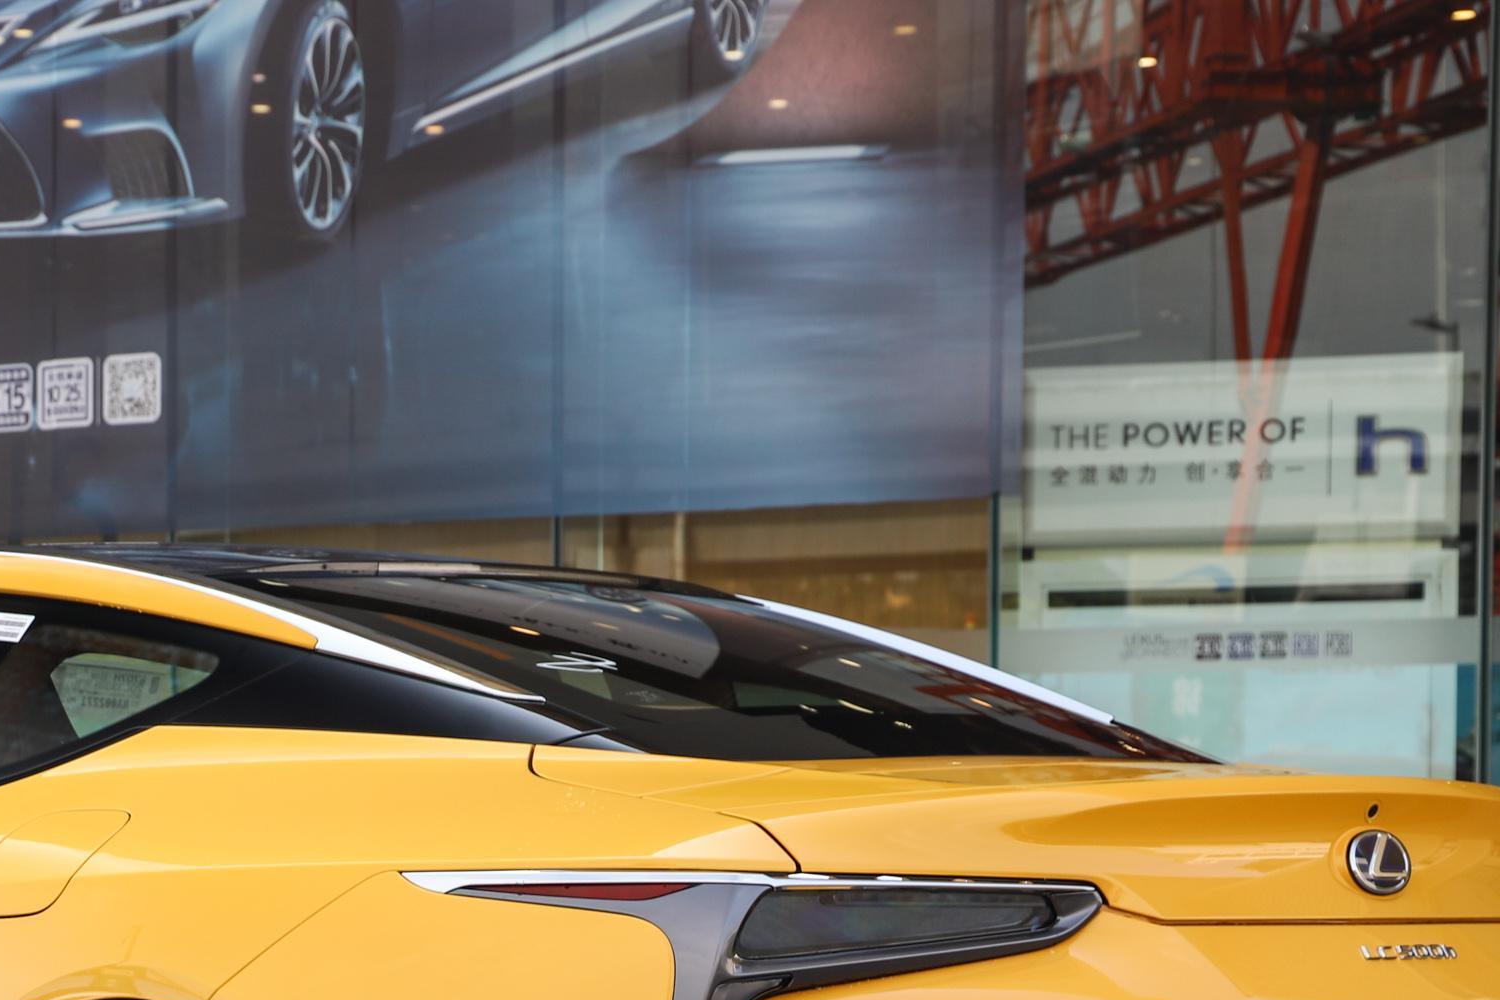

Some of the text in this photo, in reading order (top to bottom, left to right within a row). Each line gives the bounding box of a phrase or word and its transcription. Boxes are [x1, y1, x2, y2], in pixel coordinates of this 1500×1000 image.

[1051, 415, 1428, 476] THE POWER OF h
[1360, 944, 1457, 960] LC500h
